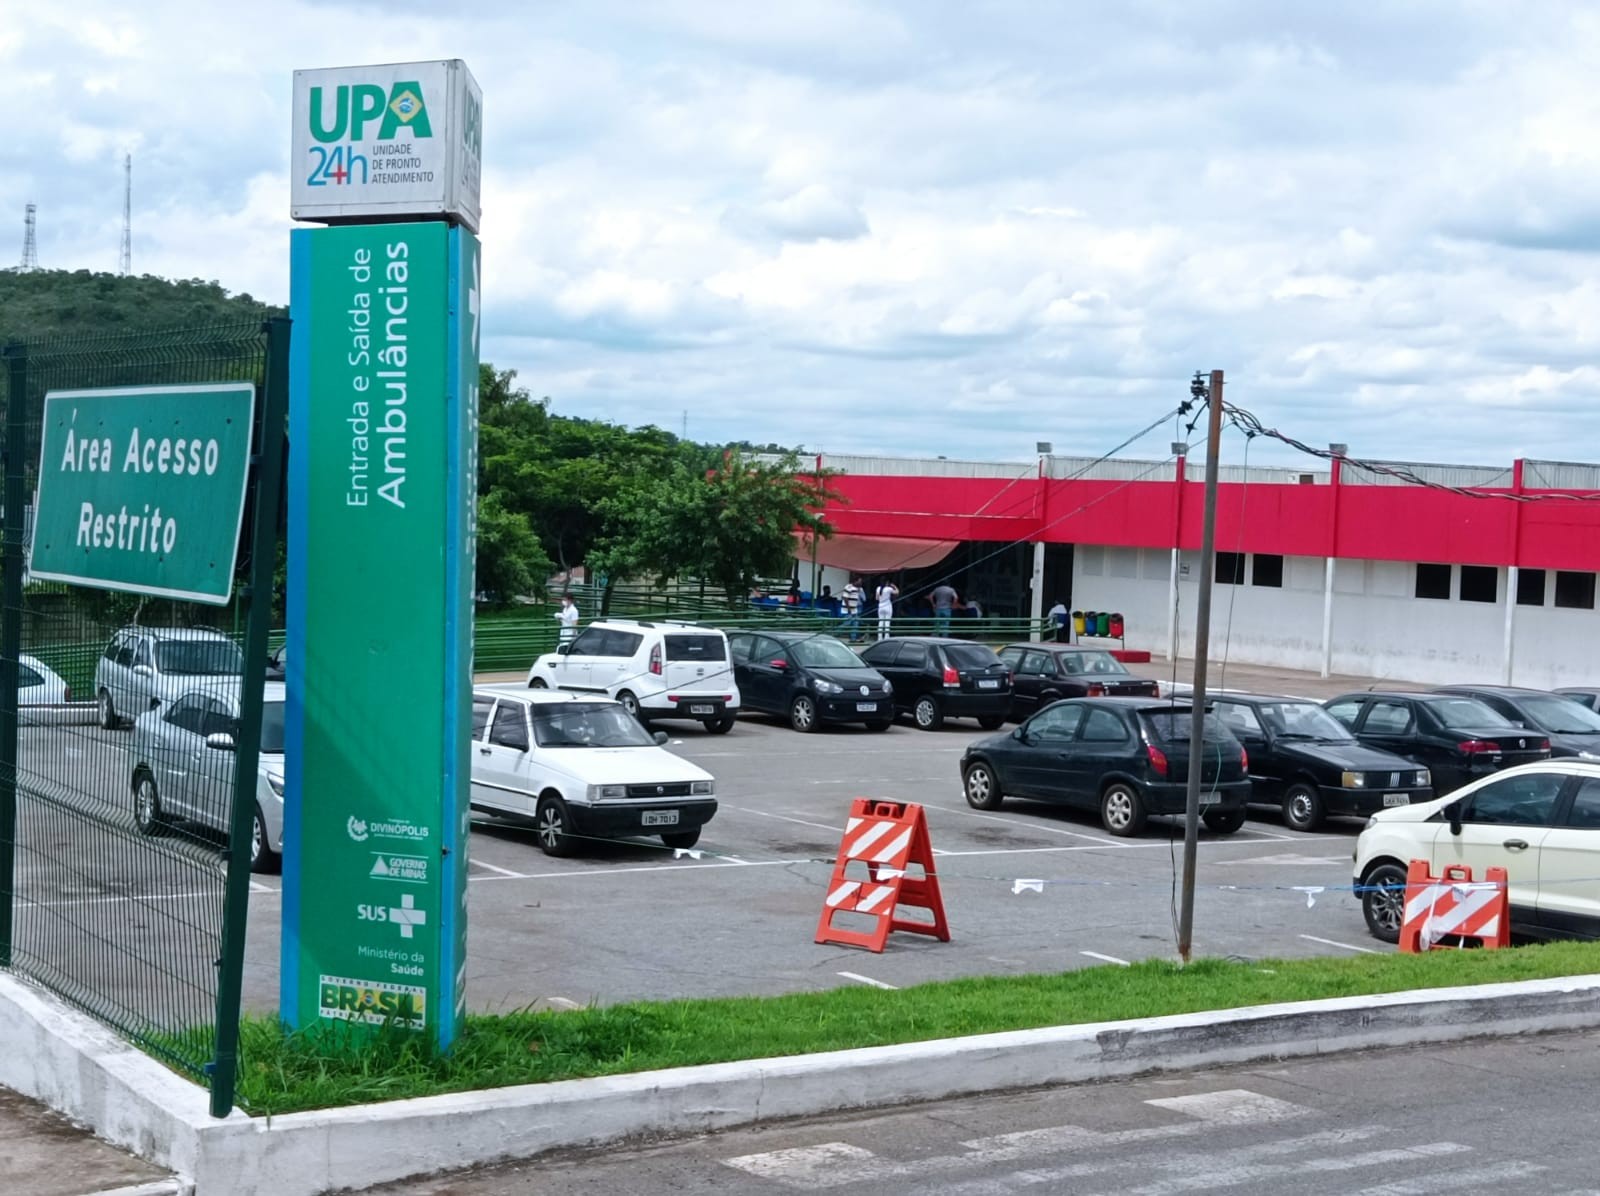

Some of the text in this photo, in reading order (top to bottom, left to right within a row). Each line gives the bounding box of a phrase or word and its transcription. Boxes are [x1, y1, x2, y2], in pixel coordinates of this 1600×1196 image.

[309, 81, 433, 143] UPA
[372, 144, 412, 155] UNIDADE
[307, 145, 367, 186] 24h
[372, 158, 421, 169] DE PRONTO
[372, 171, 434, 184] ATENDIMENTO
[346, 248, 371, 506] Entrada e Saída de
[376, 241, 409, 508] Ambulâncias
[60, 408, 218, 476] Área Acesso
[76, 502, 176, 553] Restrito
[370, 822, 429, 837] DIVINÓPOLIS
[389, 858, 427, 869] GOVERNO
[389, 867, 426, 880] DE MINAS
[357, 904, 387, 921] SUS
[358, 945, 425, 963] Ministério da
[391, 962, 424, 976] Saúde
